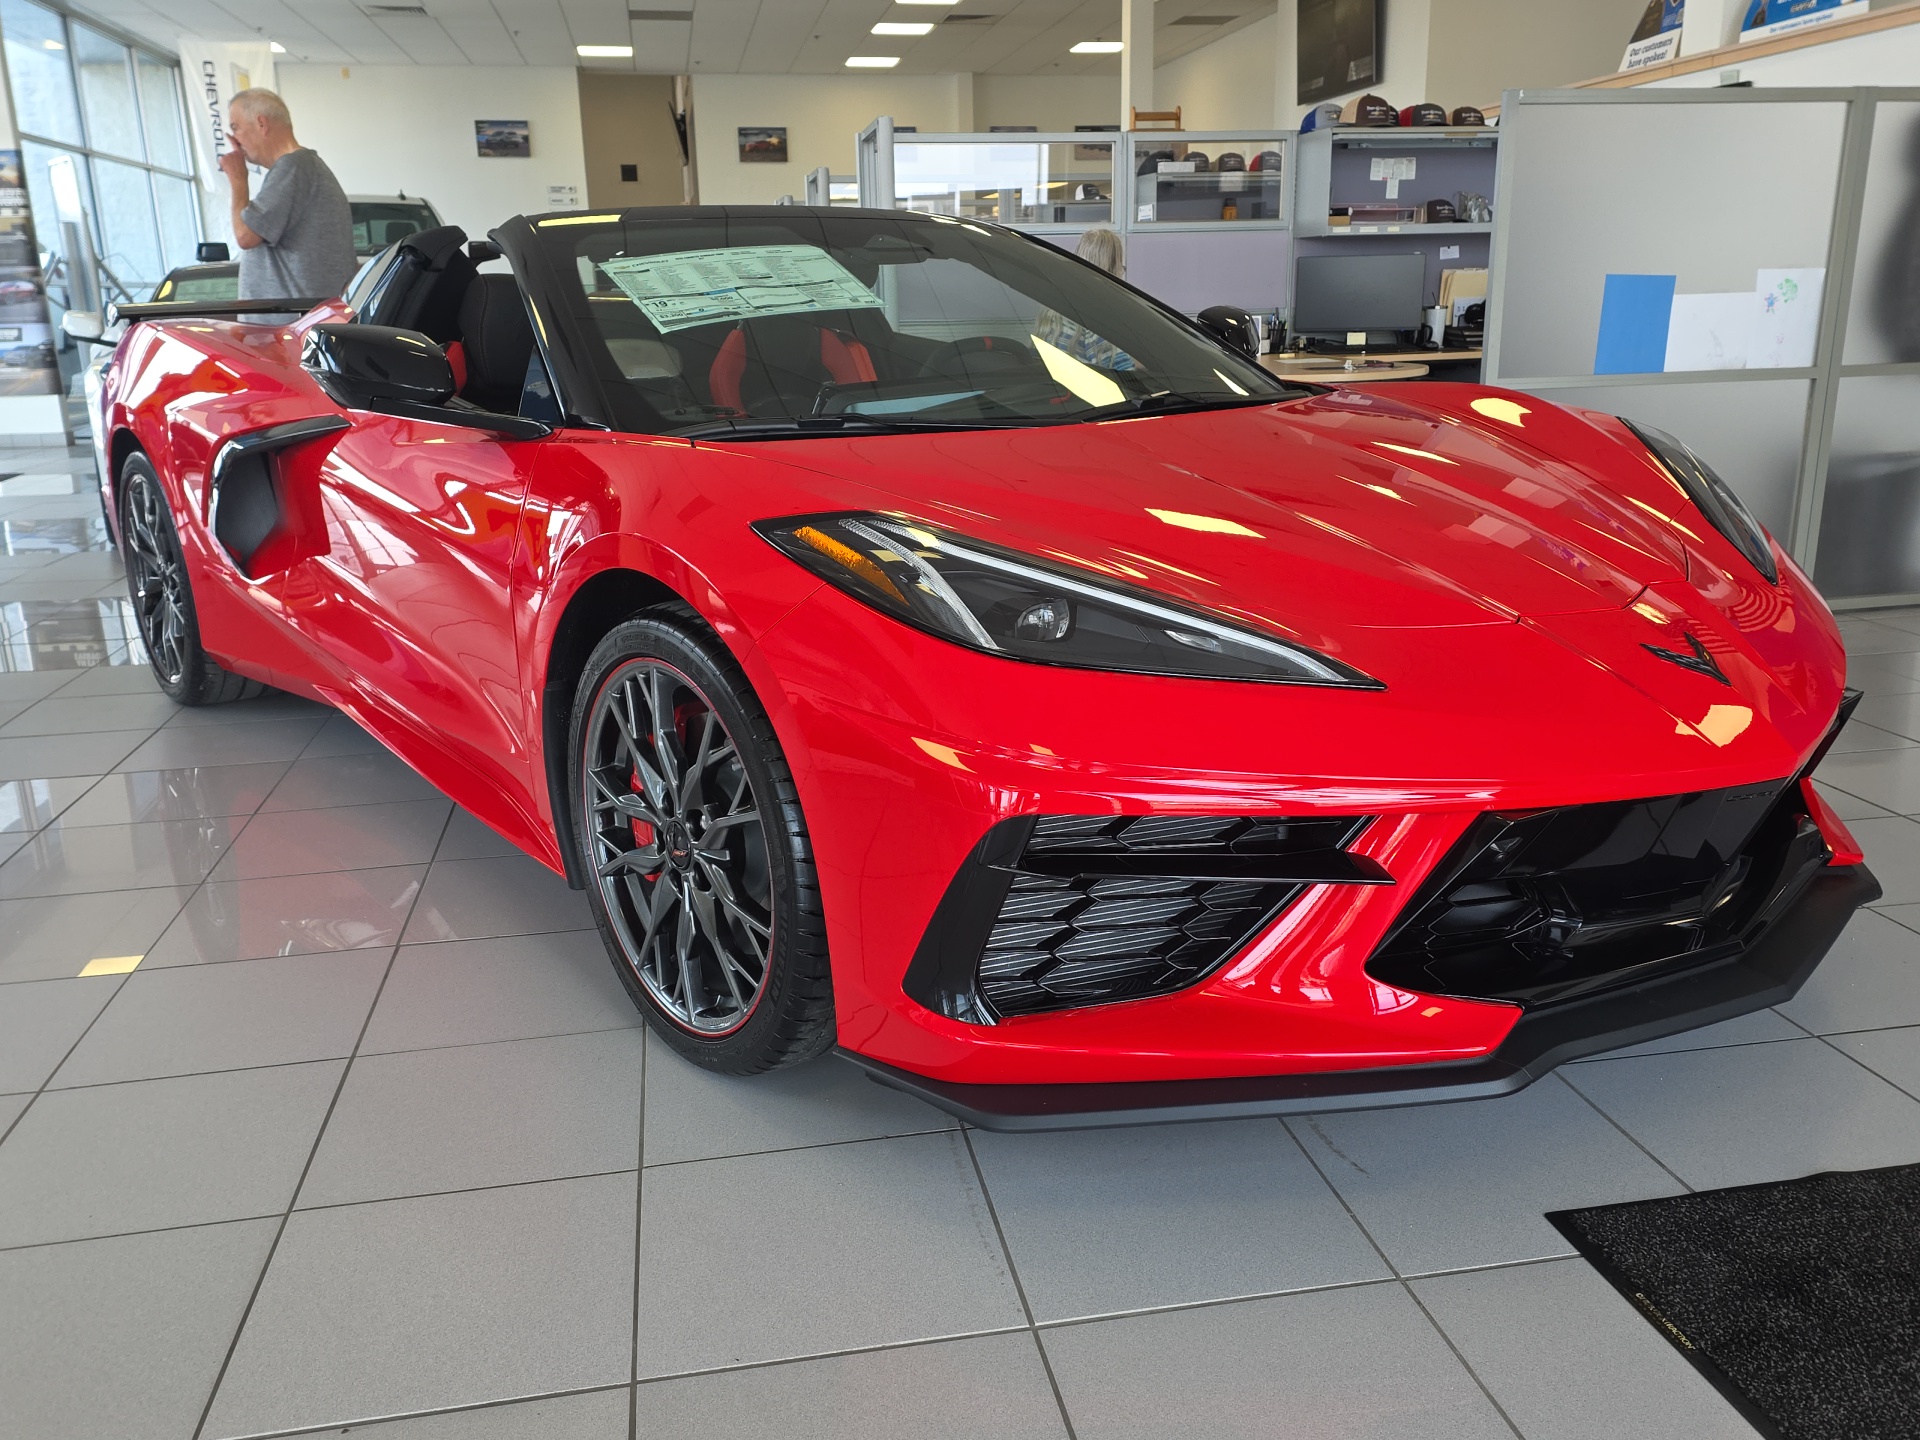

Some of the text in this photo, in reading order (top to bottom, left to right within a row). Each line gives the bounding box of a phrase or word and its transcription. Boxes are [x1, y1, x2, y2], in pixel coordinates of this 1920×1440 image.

[1627, 49, 1668, 68] have spoken!
[1630, 37, 1673, 57] Our customers
[203, 61, 226, 172] CHEVROL
[771, 900, 788, 1001] MICHELIN
